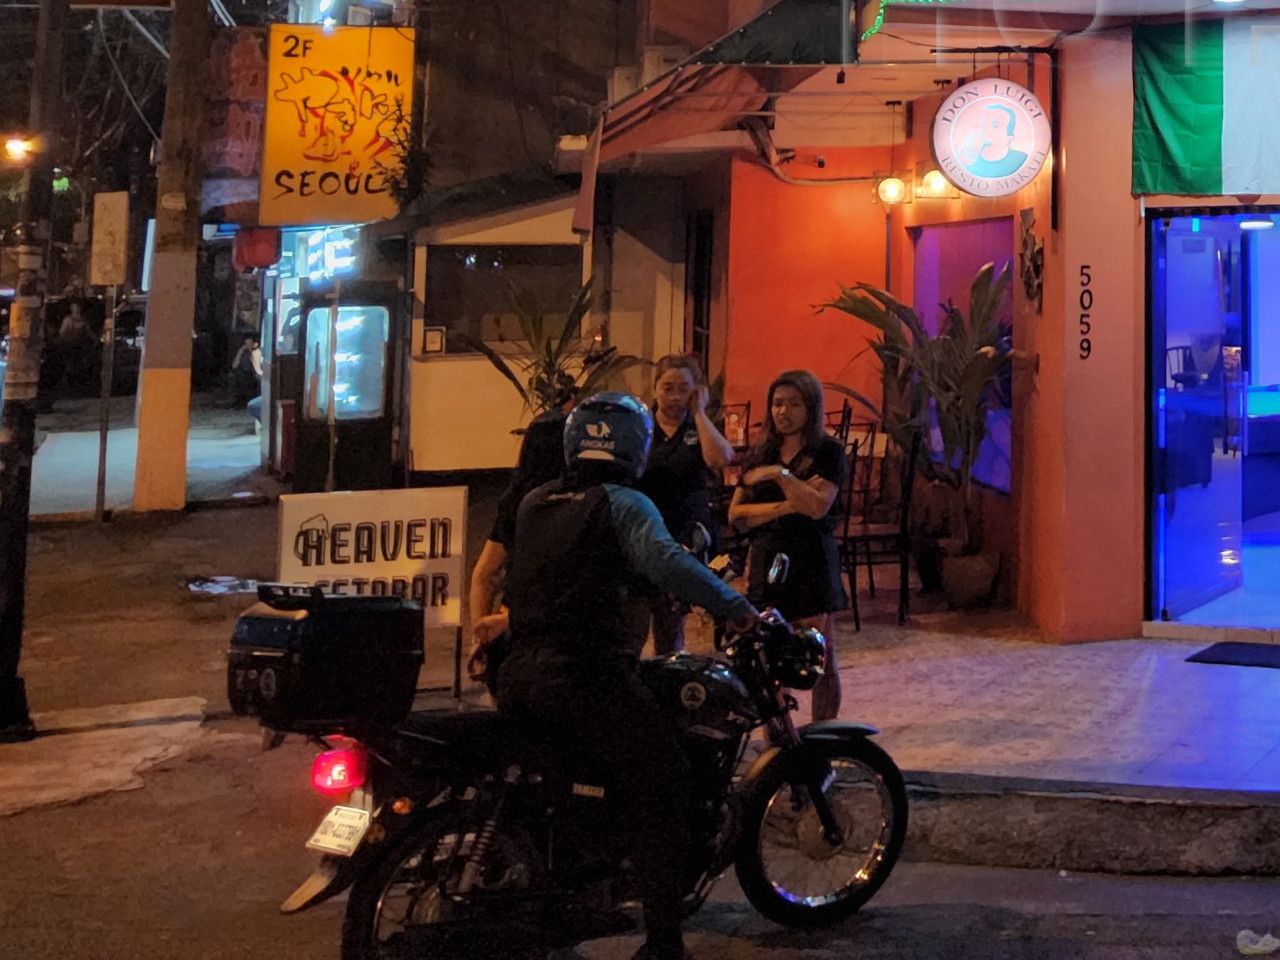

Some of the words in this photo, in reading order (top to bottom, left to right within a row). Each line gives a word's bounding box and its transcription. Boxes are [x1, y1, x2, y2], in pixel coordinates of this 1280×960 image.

[282, 34, 314, 59] 2F
[942, 87, 979, 123] DON
[992, 84, 1043, 118] LUIGI
[273, 169, 387, 200] SEOUL
[941, 156, 989, 190] RESTO
[996, 151, 1046, 189] MAKATI
[1079, 265, 1093, 360] 5059
[301, 517, 452, 567] HEAVEN
